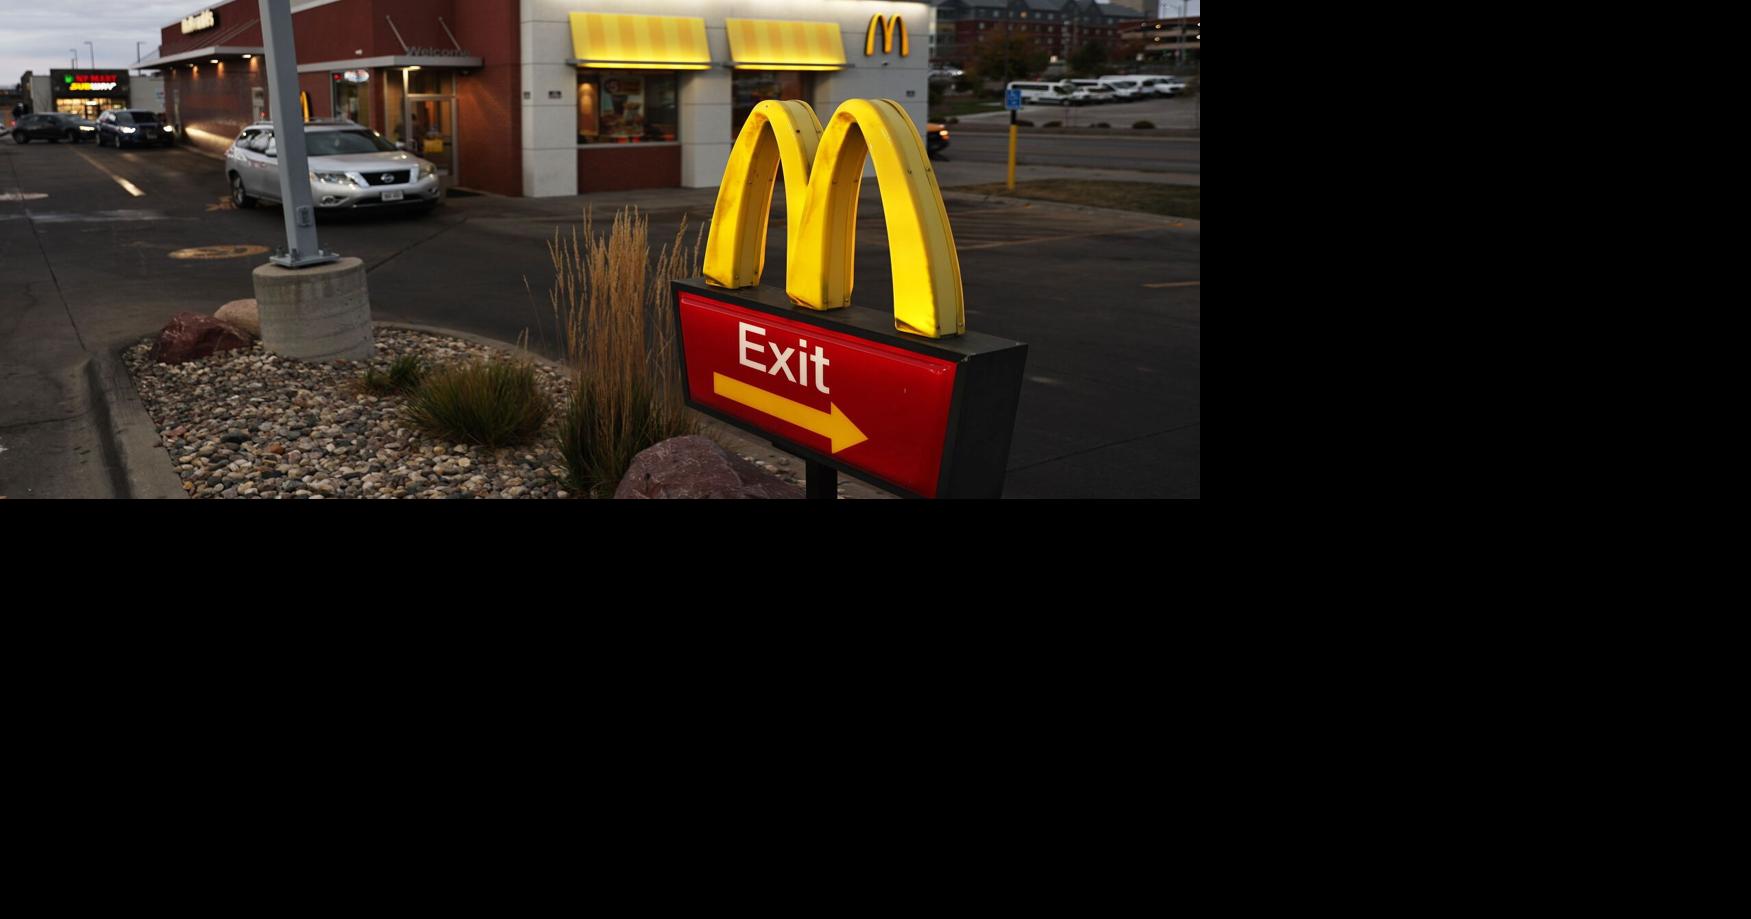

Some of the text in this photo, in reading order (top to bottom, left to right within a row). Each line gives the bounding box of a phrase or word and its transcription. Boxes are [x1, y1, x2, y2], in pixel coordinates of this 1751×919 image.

[406, 46, 471, 57] Welcome
[69, 82, 117, 91] SUBWAY
[738, 321, 830, 395] Exit
